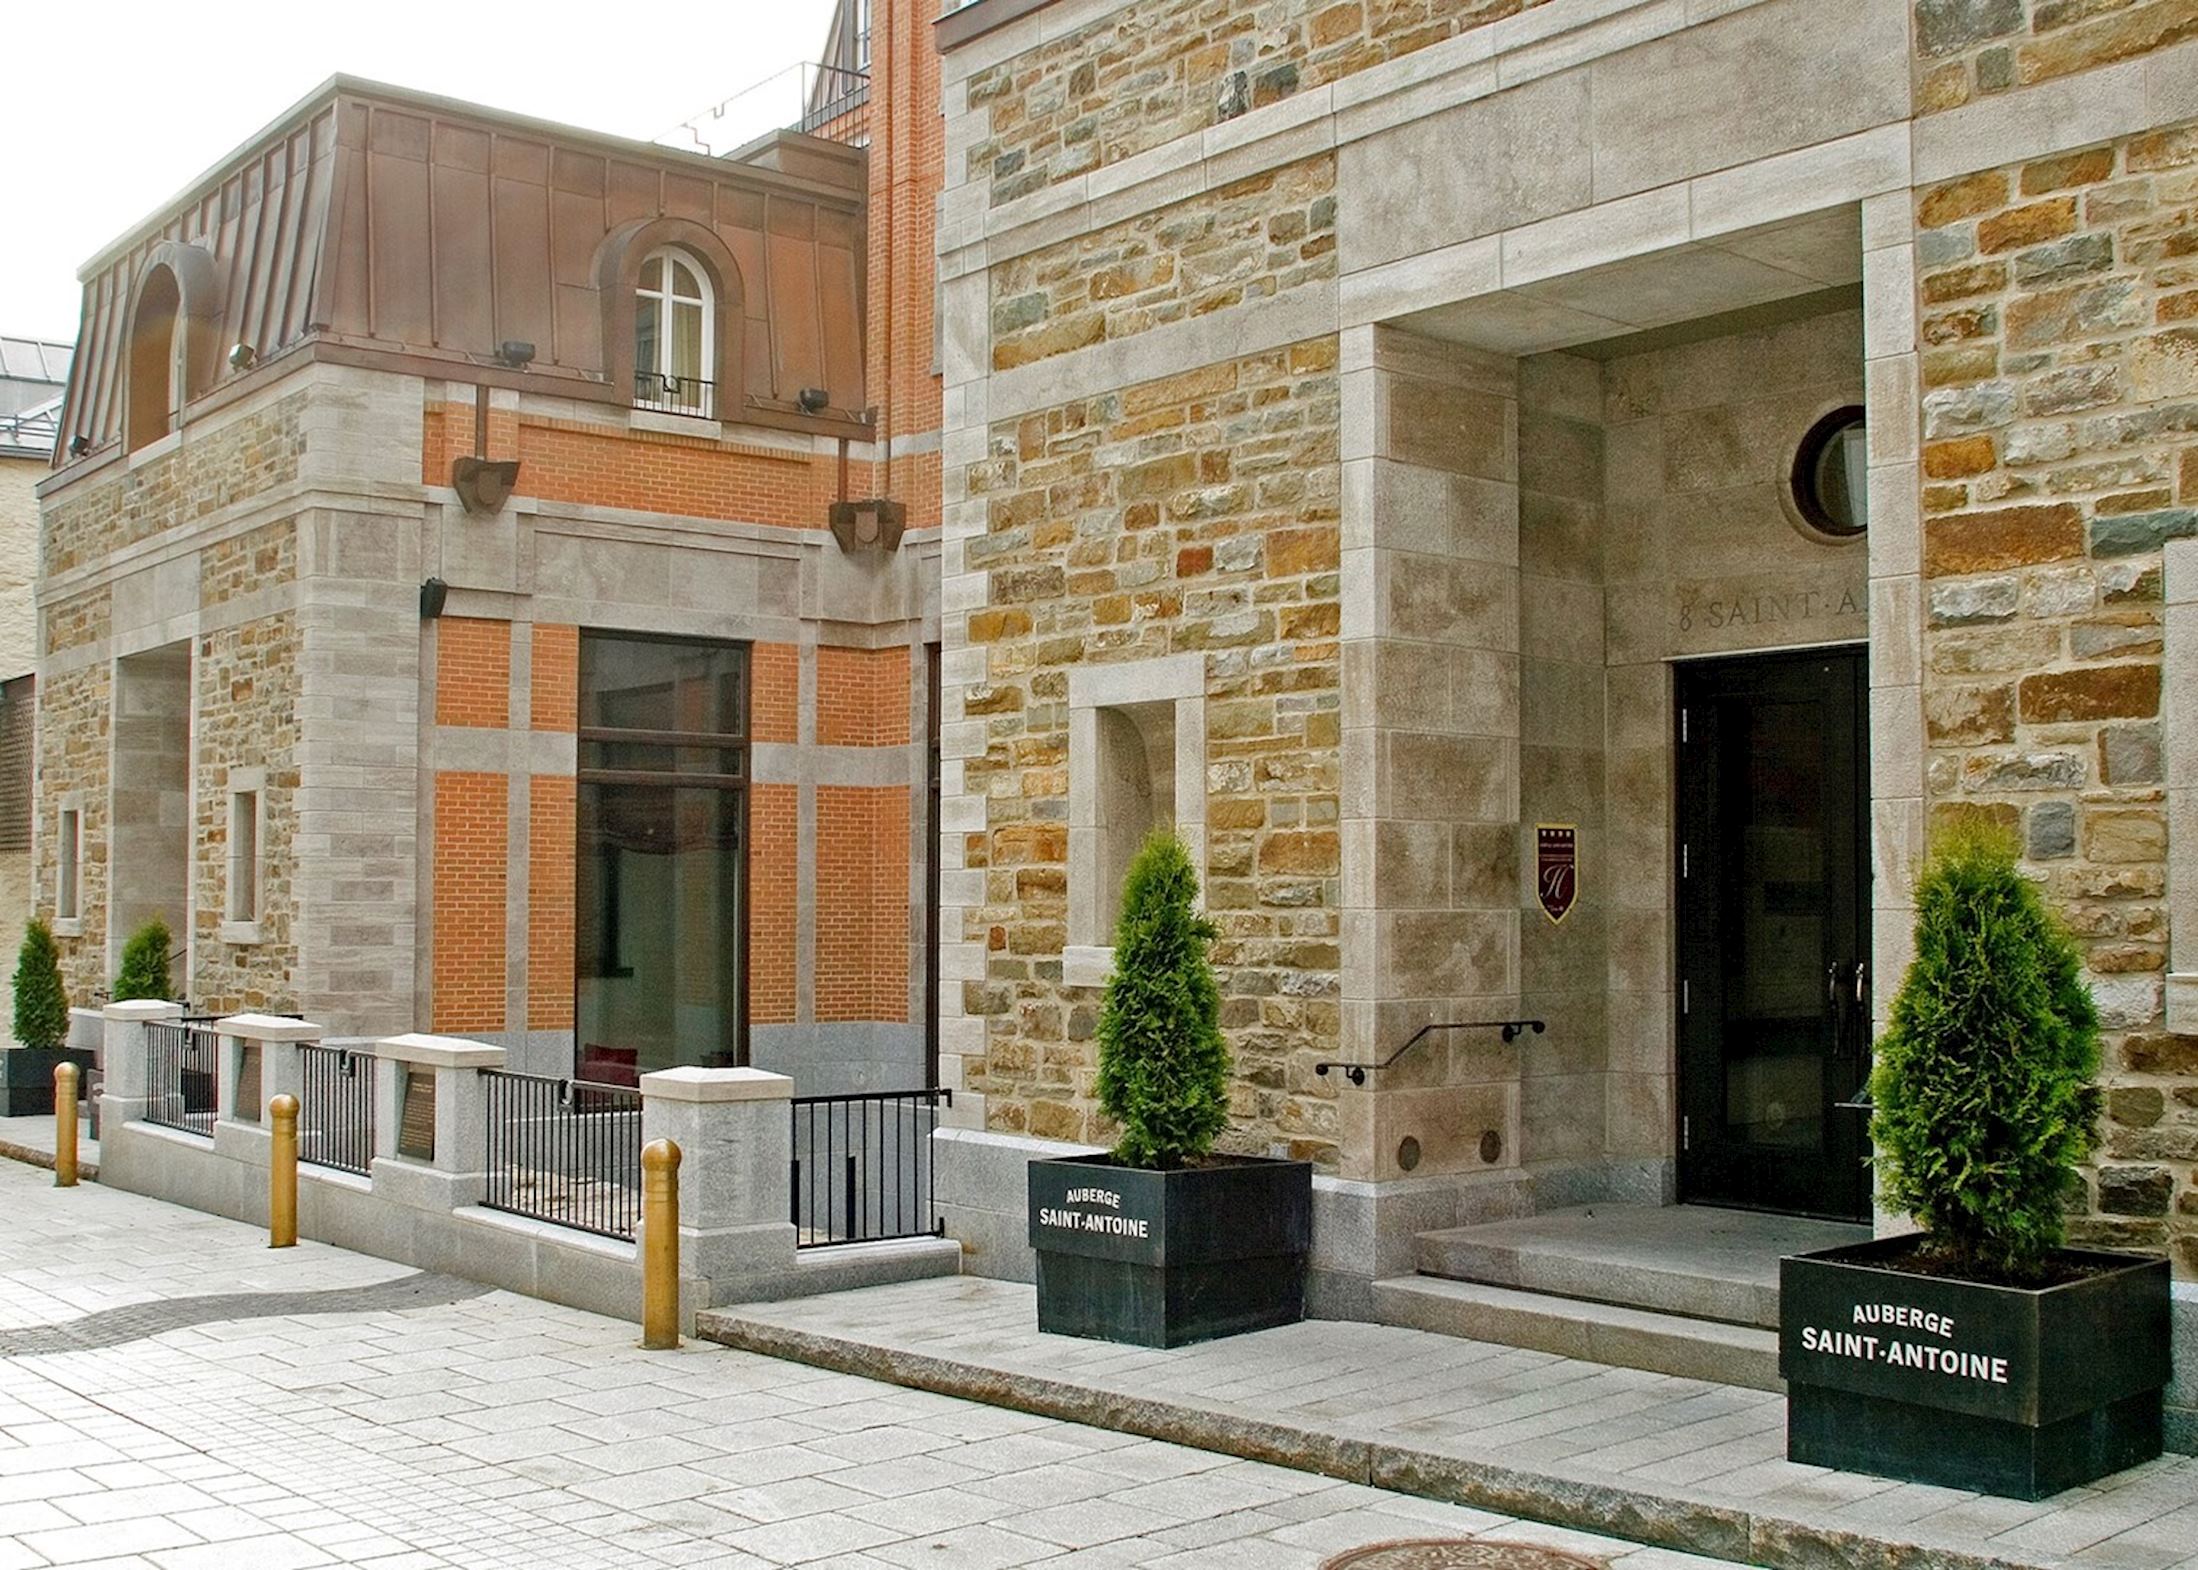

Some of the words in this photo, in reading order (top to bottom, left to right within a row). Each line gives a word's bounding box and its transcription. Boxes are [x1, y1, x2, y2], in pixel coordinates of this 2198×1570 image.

[1679, 604, 1692, 632] 8
[1066, 1187, 1121, 1210] AUBERGE
[1852, 1303, 1955, 1339] AUBERGE
